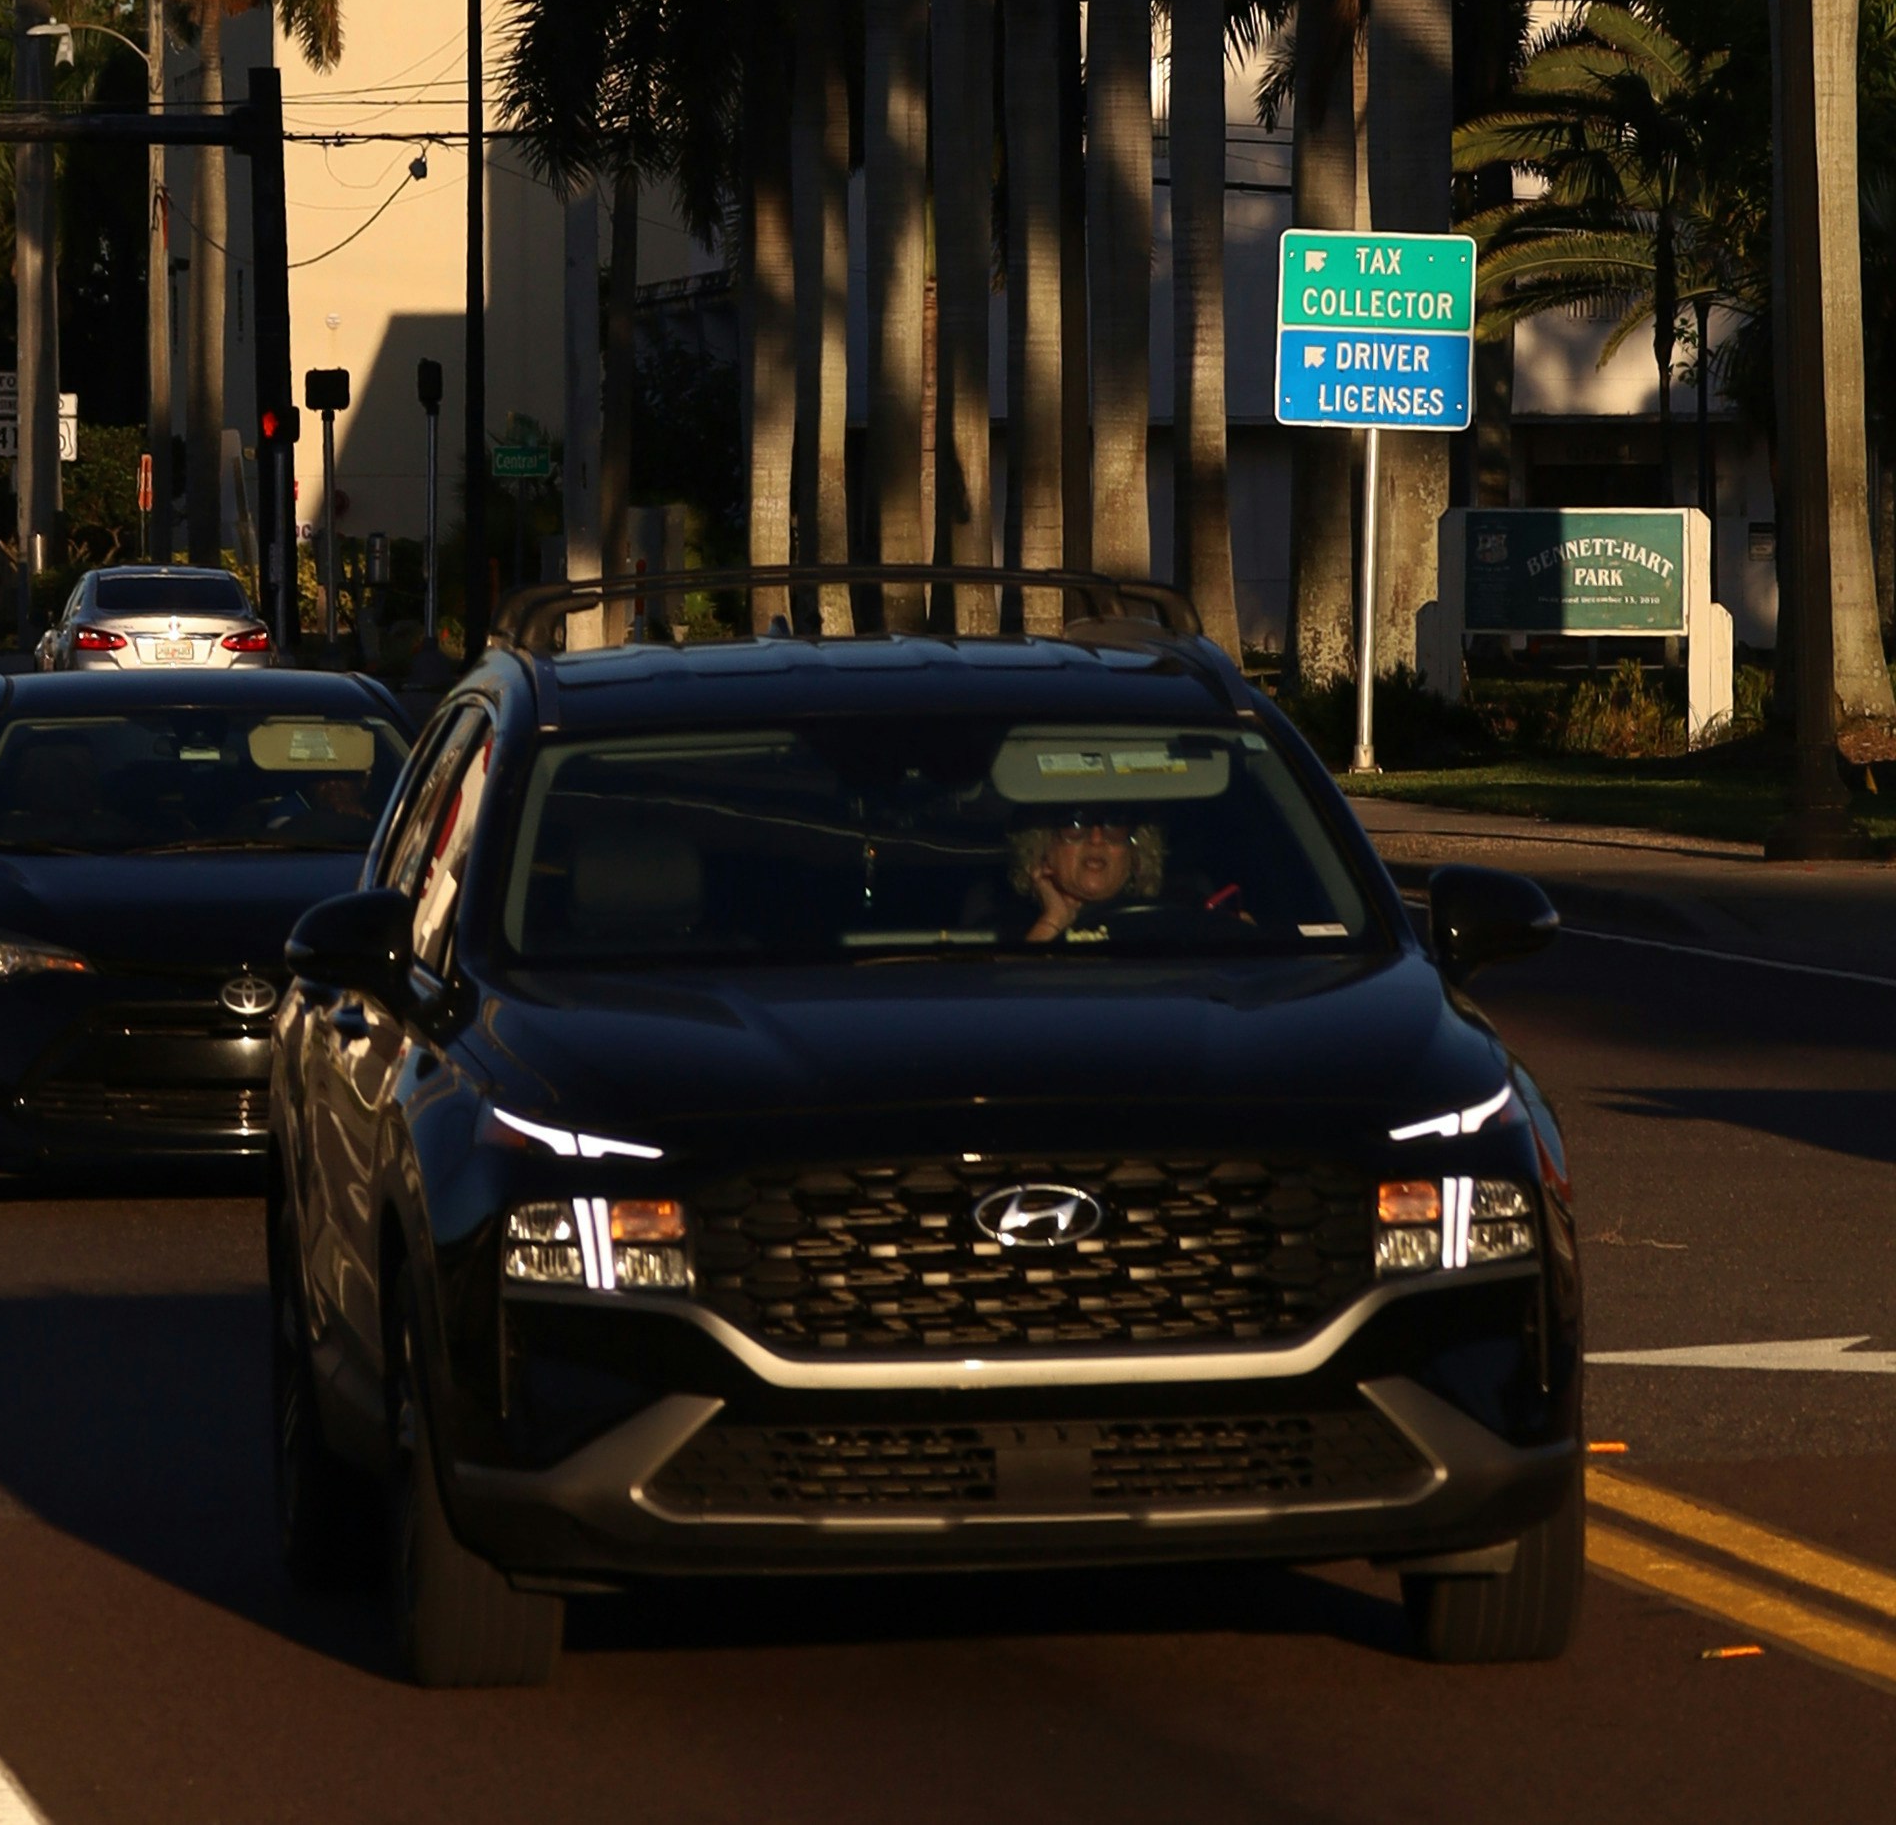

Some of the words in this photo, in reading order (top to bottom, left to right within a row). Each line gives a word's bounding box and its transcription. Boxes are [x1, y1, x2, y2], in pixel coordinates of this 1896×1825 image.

[1355, 247, 1403, 276] TAX
[1302, 287, 1454, 320] COLLECTOR
[1335, 342, 1430, 373] DRIVER
[1318, 383, 1445, 416] LICENSES
[495, 452, 538, 470] Central
[1526, 537, 1675, 579] BENNETT-HART
[1574, 567, 1624, 587] PARK
